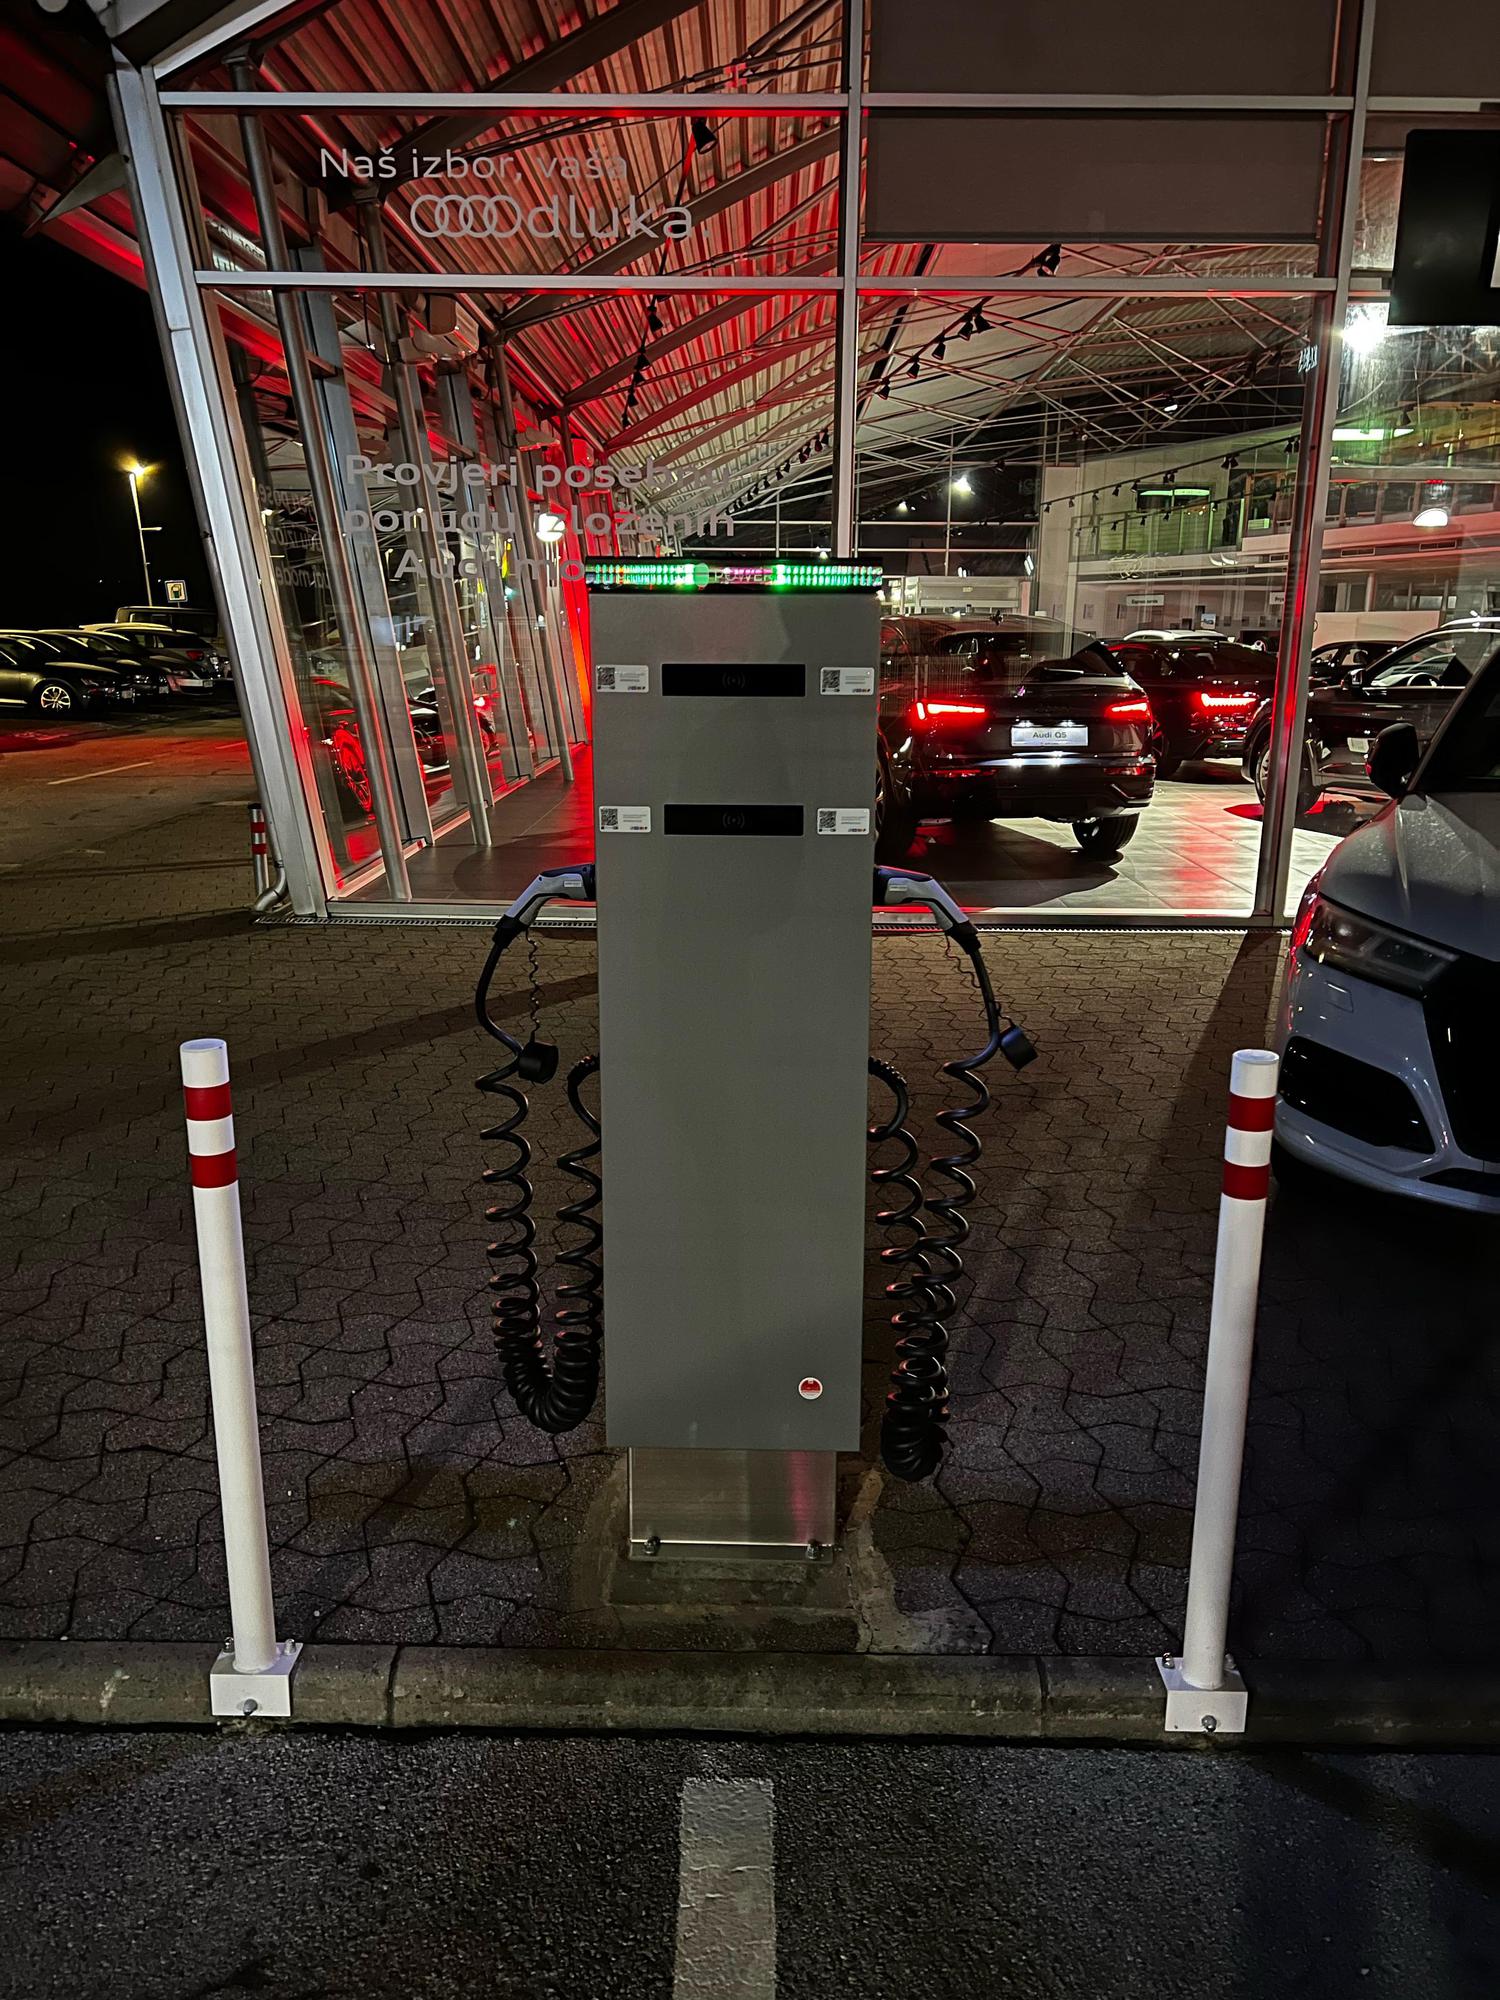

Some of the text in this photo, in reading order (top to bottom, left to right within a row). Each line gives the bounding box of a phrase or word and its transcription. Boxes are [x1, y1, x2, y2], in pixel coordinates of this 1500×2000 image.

[320, 147, 629, 182] Naš izbor, vaša
[346, 454, 518, 490] Provjeri
[344, 504, 516, 537] ponudu
[395, 550, 500, 581] Audi
[1032, 731, 1067, 739] Audi Q5
